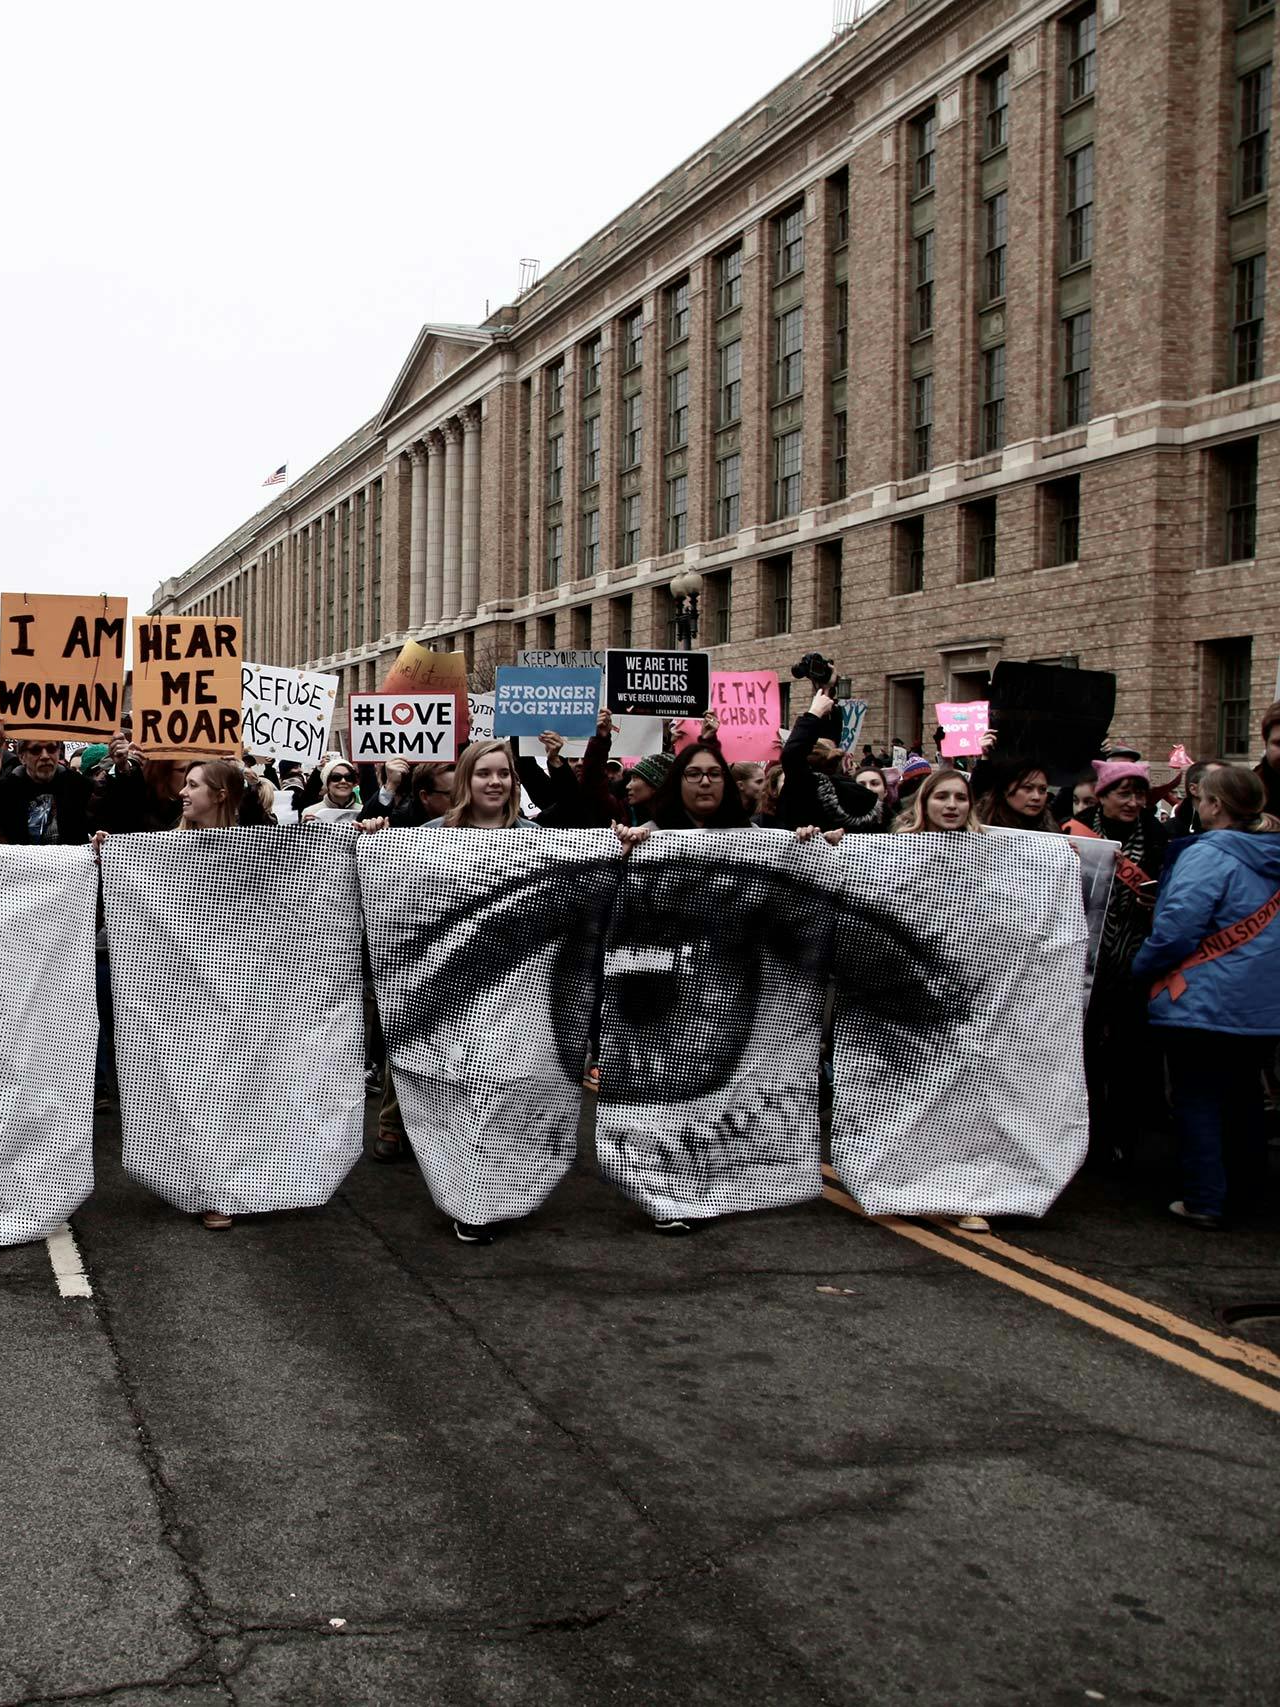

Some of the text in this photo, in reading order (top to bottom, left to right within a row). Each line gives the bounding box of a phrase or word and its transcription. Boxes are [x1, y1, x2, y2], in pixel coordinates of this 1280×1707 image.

[9, 614, 124, 658] I AM
[139, 624, 237, 663] HEAR
[523, 652, 551, 664] KEEP
[553, 652, 577, 665] YOUR
[626, 657, 688, 671] WE ARE THE
[161, 670, 217, 705] ME
[241, 668, 324, 710] REFUSE
[499, 685, 596, 699] STRONGER
[627, 673, 688, 691] LEADERS
[732, 681, 772, 705] THY
[0, 681, 117, 721] WOMAN
[499, 701, 595, 715] TOGETHER
[618, 693, 697, 704] WE'VE BEEN LOOKING FOR.
[140, 708, 240, 744] ROAR
[354, 703, 452, 726] #LOVE
[241, 707, 324, 760] ASCISM
[359, 731, 446, 753] ARMY
